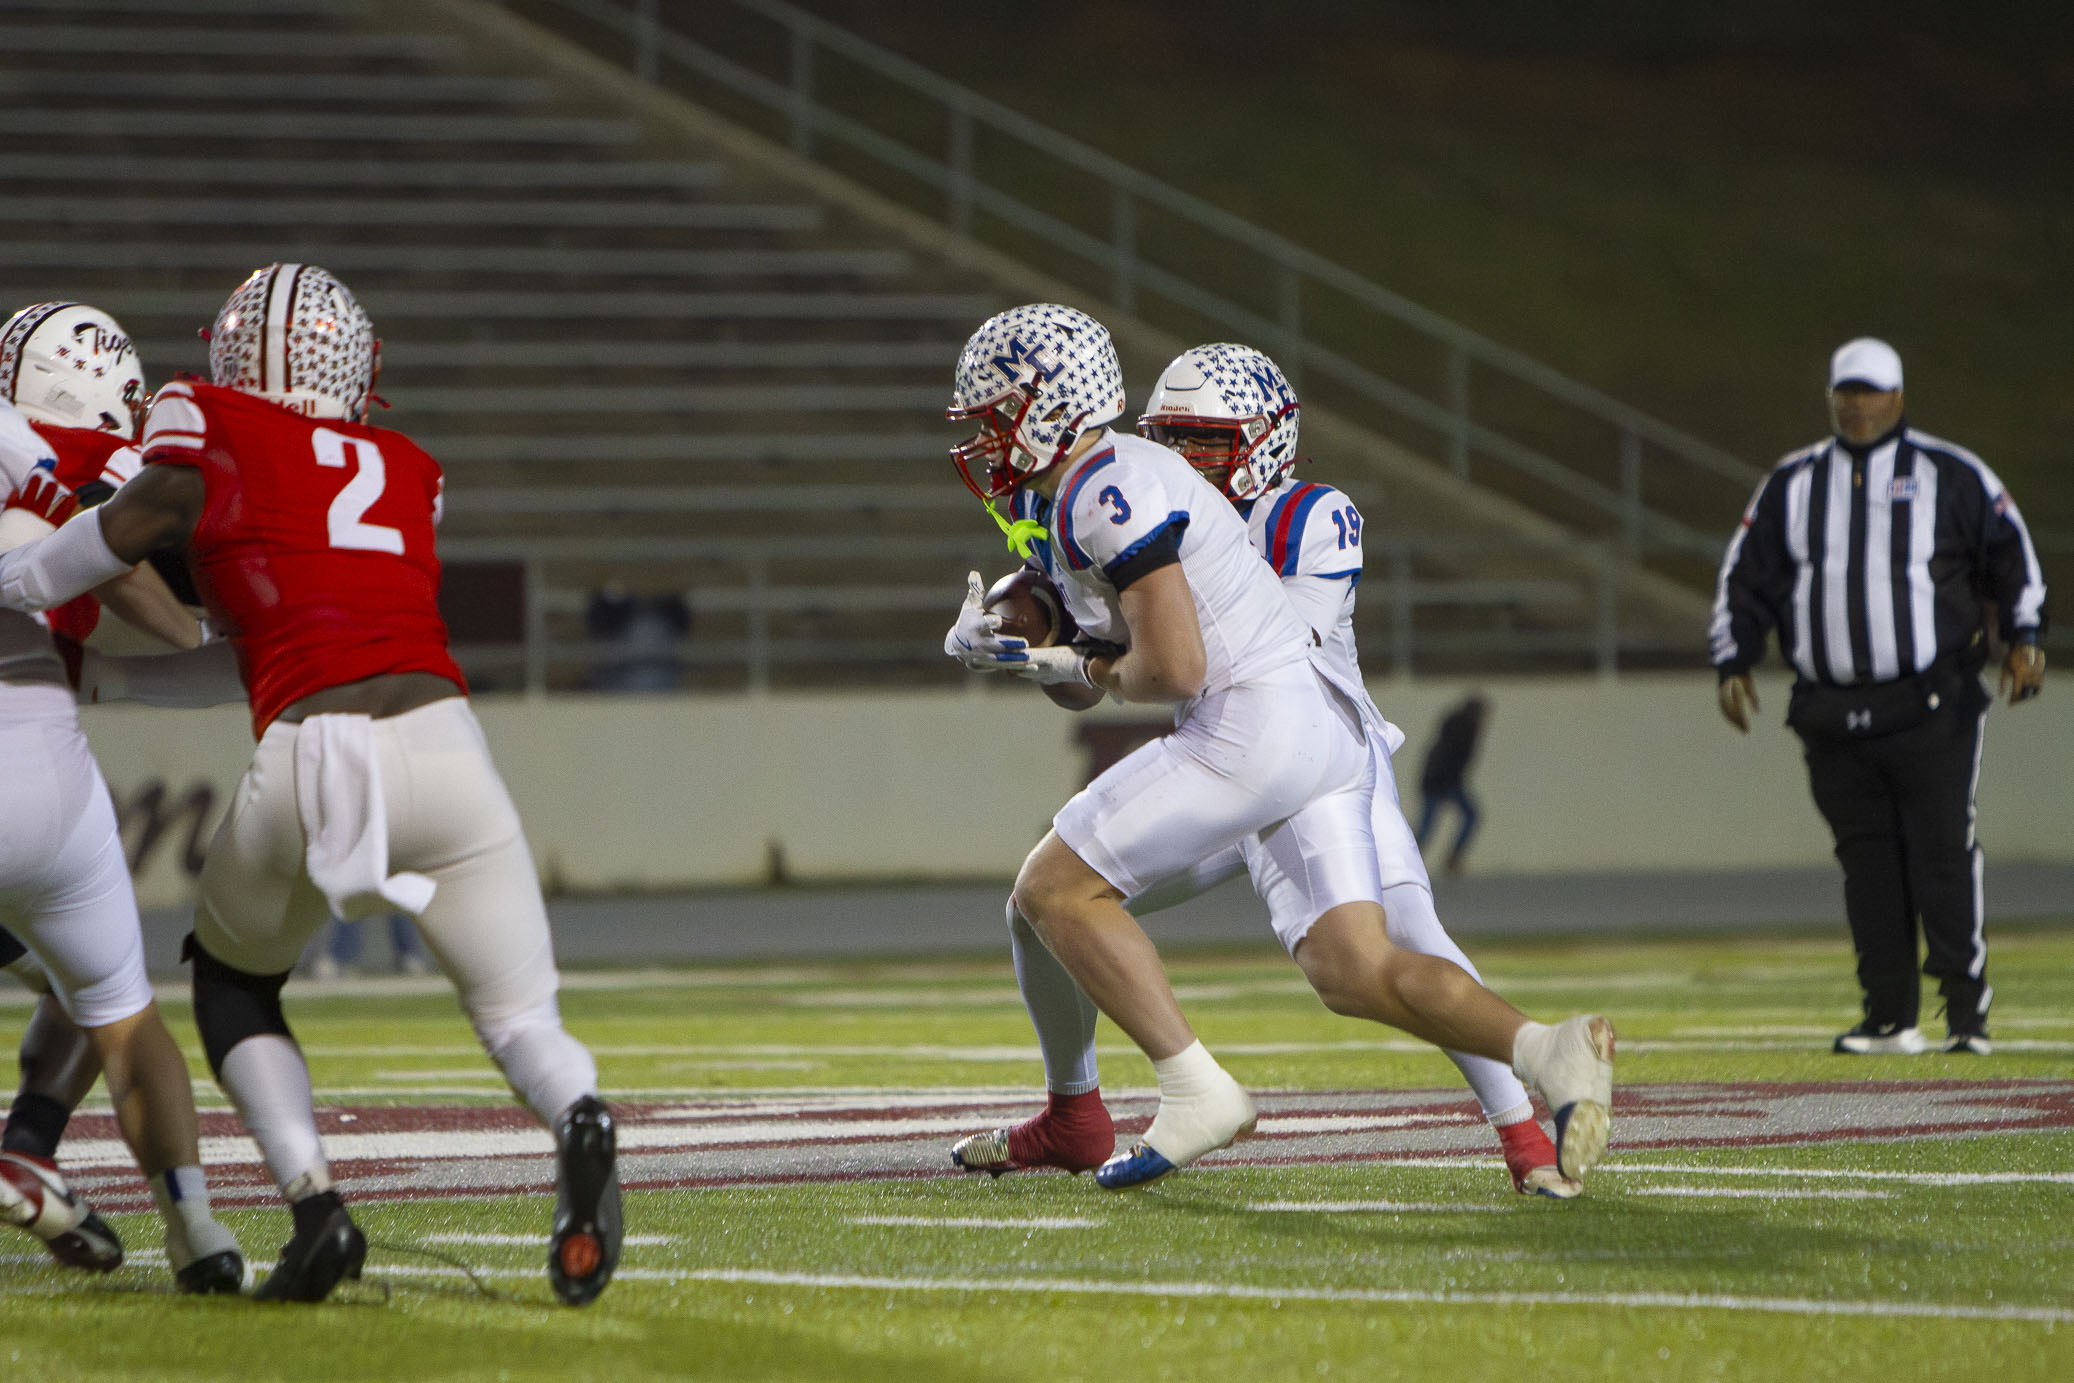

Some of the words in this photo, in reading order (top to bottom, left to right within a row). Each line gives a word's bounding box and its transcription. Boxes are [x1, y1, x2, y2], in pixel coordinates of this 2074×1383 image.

[988, 334, 1067, 386] MC
[311, 426, 405, 556] 2
[1098, 484, 1131, 525] 3
[1331, 505, 1361, 551] 19
